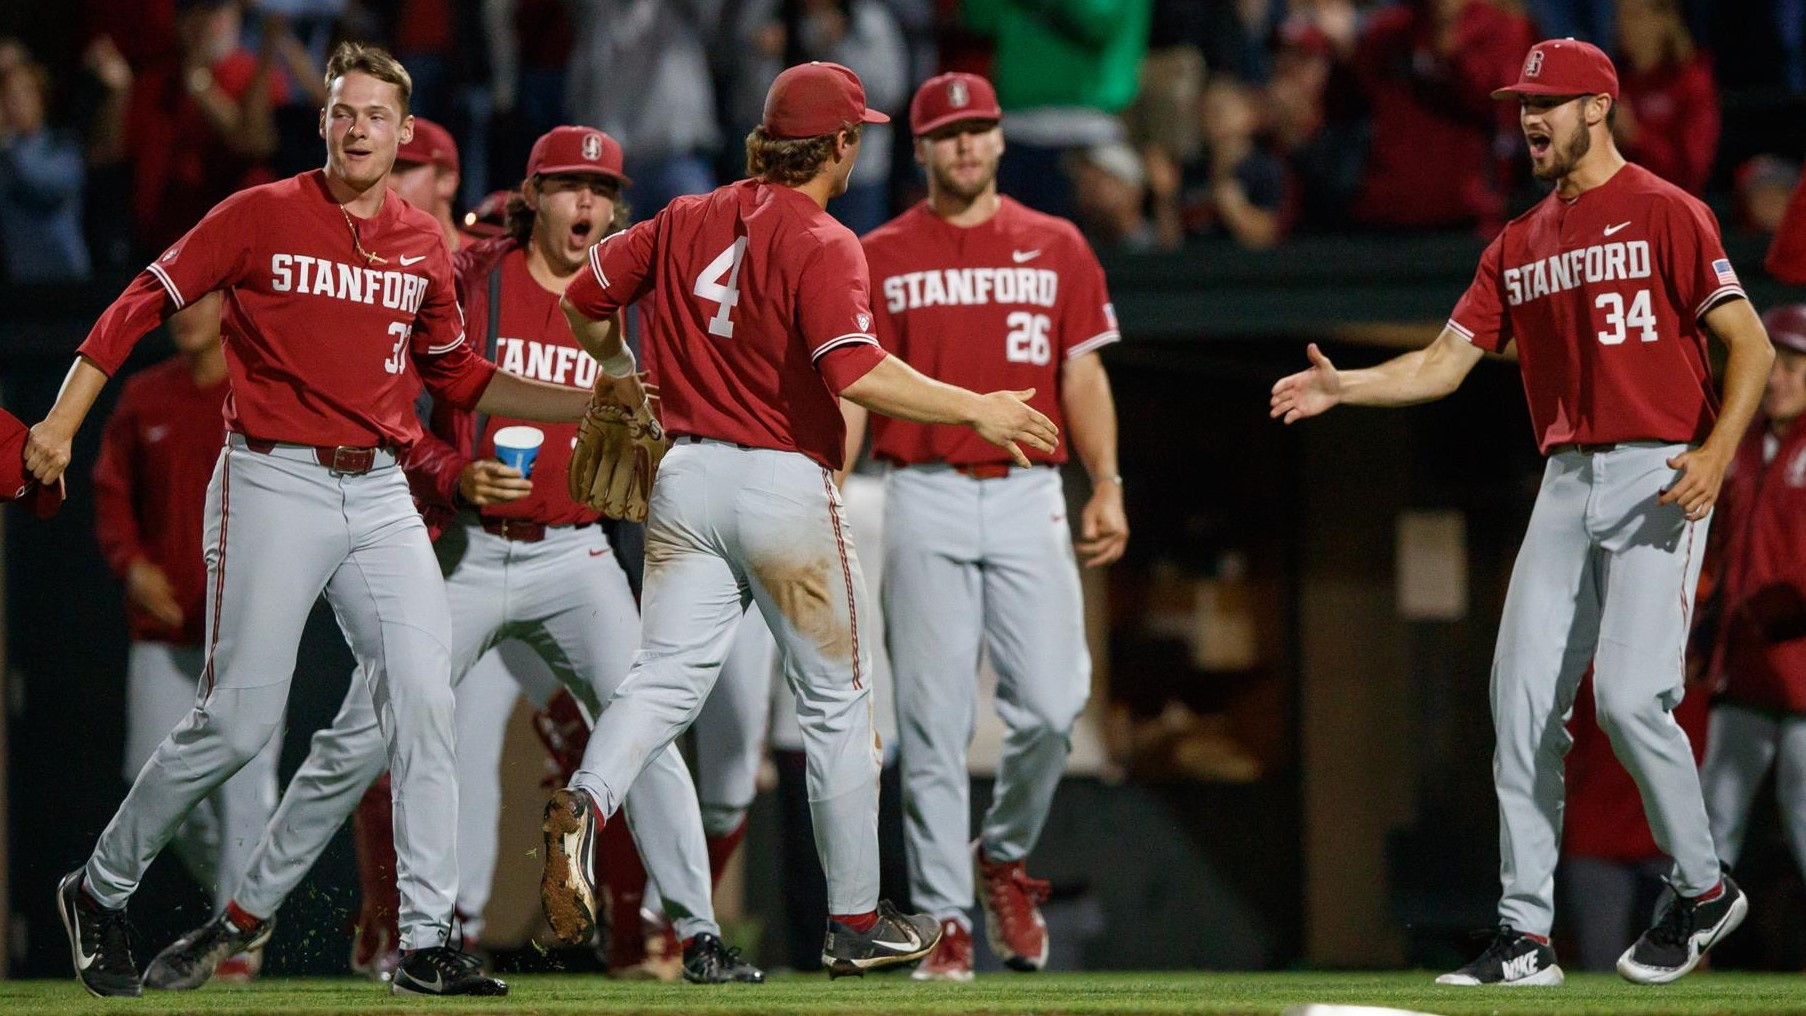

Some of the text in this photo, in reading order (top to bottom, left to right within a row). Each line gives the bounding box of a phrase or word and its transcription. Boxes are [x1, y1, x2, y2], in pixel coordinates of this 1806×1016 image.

[693, 235, 748, 339] 4
[883, 267, 1058, 315] STANFORD
[1503, 240, 1651, 306] STANFORD
[1006, 311, 1051, 366] 26
[1595, 289, 1658, 345] 34
[496, 337, 603, 389] ANFO
[1501, 949, 1539, 980] NIKE
